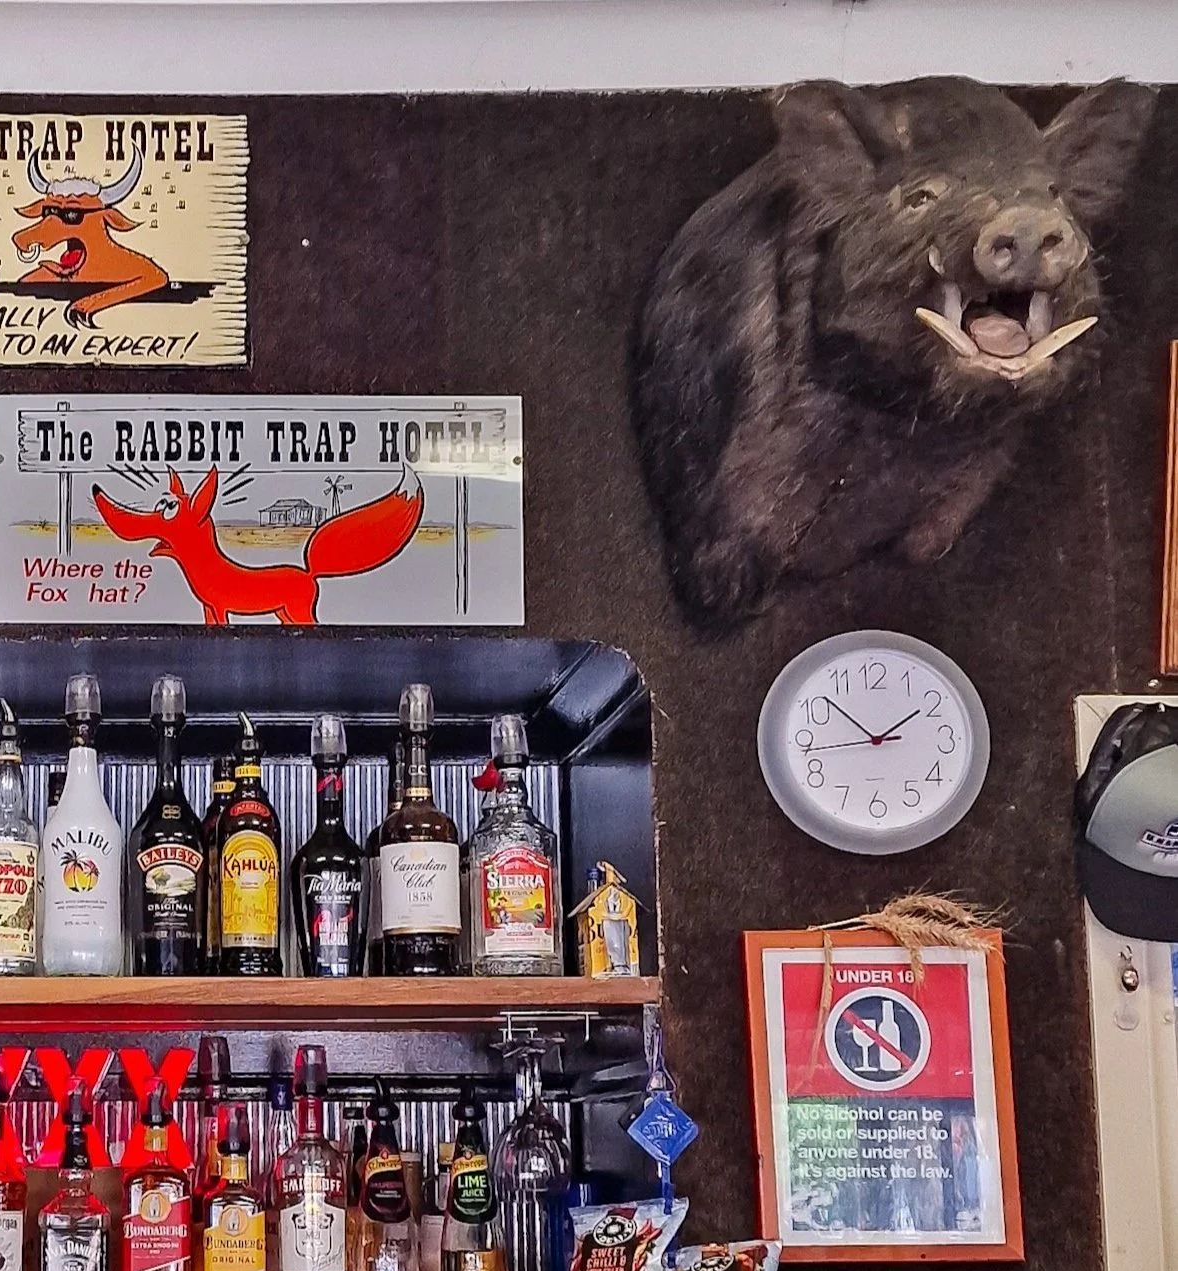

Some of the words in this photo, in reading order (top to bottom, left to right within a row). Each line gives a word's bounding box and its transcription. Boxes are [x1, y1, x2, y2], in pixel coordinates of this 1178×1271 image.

[105, 120, 215, 161] HOTEL
[3, 334, 35, 356] TO
[41, 335, 75, 357] AN
[82, 333, 198, 359] EXPERT!
[37, 421, 93, 461] The
[114, 421, 244, 462] RABBIT
[267, 421, 356, 463] TRAP
[379, 421, 488, 464] HOTEL
[22, 558, 104, 579] Where
[114, 559, 152, 579] the
[26, 583, 68, 603] Fox
[89, 583, 146, 603] hat?
[830, 670, 849, 694] 11
[859, 663, 887, 690] 12
[901, 671, 910, 696] 1
[801, 696, 830, 725] 10
[924, 690, 942, 717] 2
[795, 729, 813, 756] 9
[938, 725, 955, 754] 3
[807, 759, 824, 788] 8
[925, 761, 943, 786] 4
[835, 786, 850, 810] 7
[869, 791, 887, 818] 6
[902, 780, 921, 807] 5
[50, 830, 113, 857] MALIBU
[142, 846, 199, 866] BAILEYS
[223, 855, 276, 879] KAHLÚA
[391, 856, 447, 873] Canadian
[402, 872, 435, 888] Club
[487, 872, 545, 889] SIERRA
[148, 903, 194, 912] ORIGINAL
[836, 970, 893, 983] UNDER
[897, 970, 916, 983] 18
[797, 1107, 820, 1121] No
[824, 1107, 884, 1121] alcohol
[890, 1110, 918, 1121] can
[923, 1108, 943, 1121] be
[798, 1127, 832, 1140] sold
[836, 1130, 853, 1140] or
[858, 1126, 927, 1144] supplied
[932, 1128, 949, 1140] to
[798, 1149, 859, 1162] anyone
[862, 1146, 911, 1158] under
[915, 1146, 938, 1158] 18.
[458, 1176, 487, 1187] LIME
[828, 1165, 887, 1181] against
[891, 1165, 917, 1178] the
[920, 1166, 954, 1179] law.
[123, 1223, 187, 1238] BUNDABERG
[205, 1237, 265, 1250] BUNDABERG
[591, 1247, 626, 1259] SWEET
